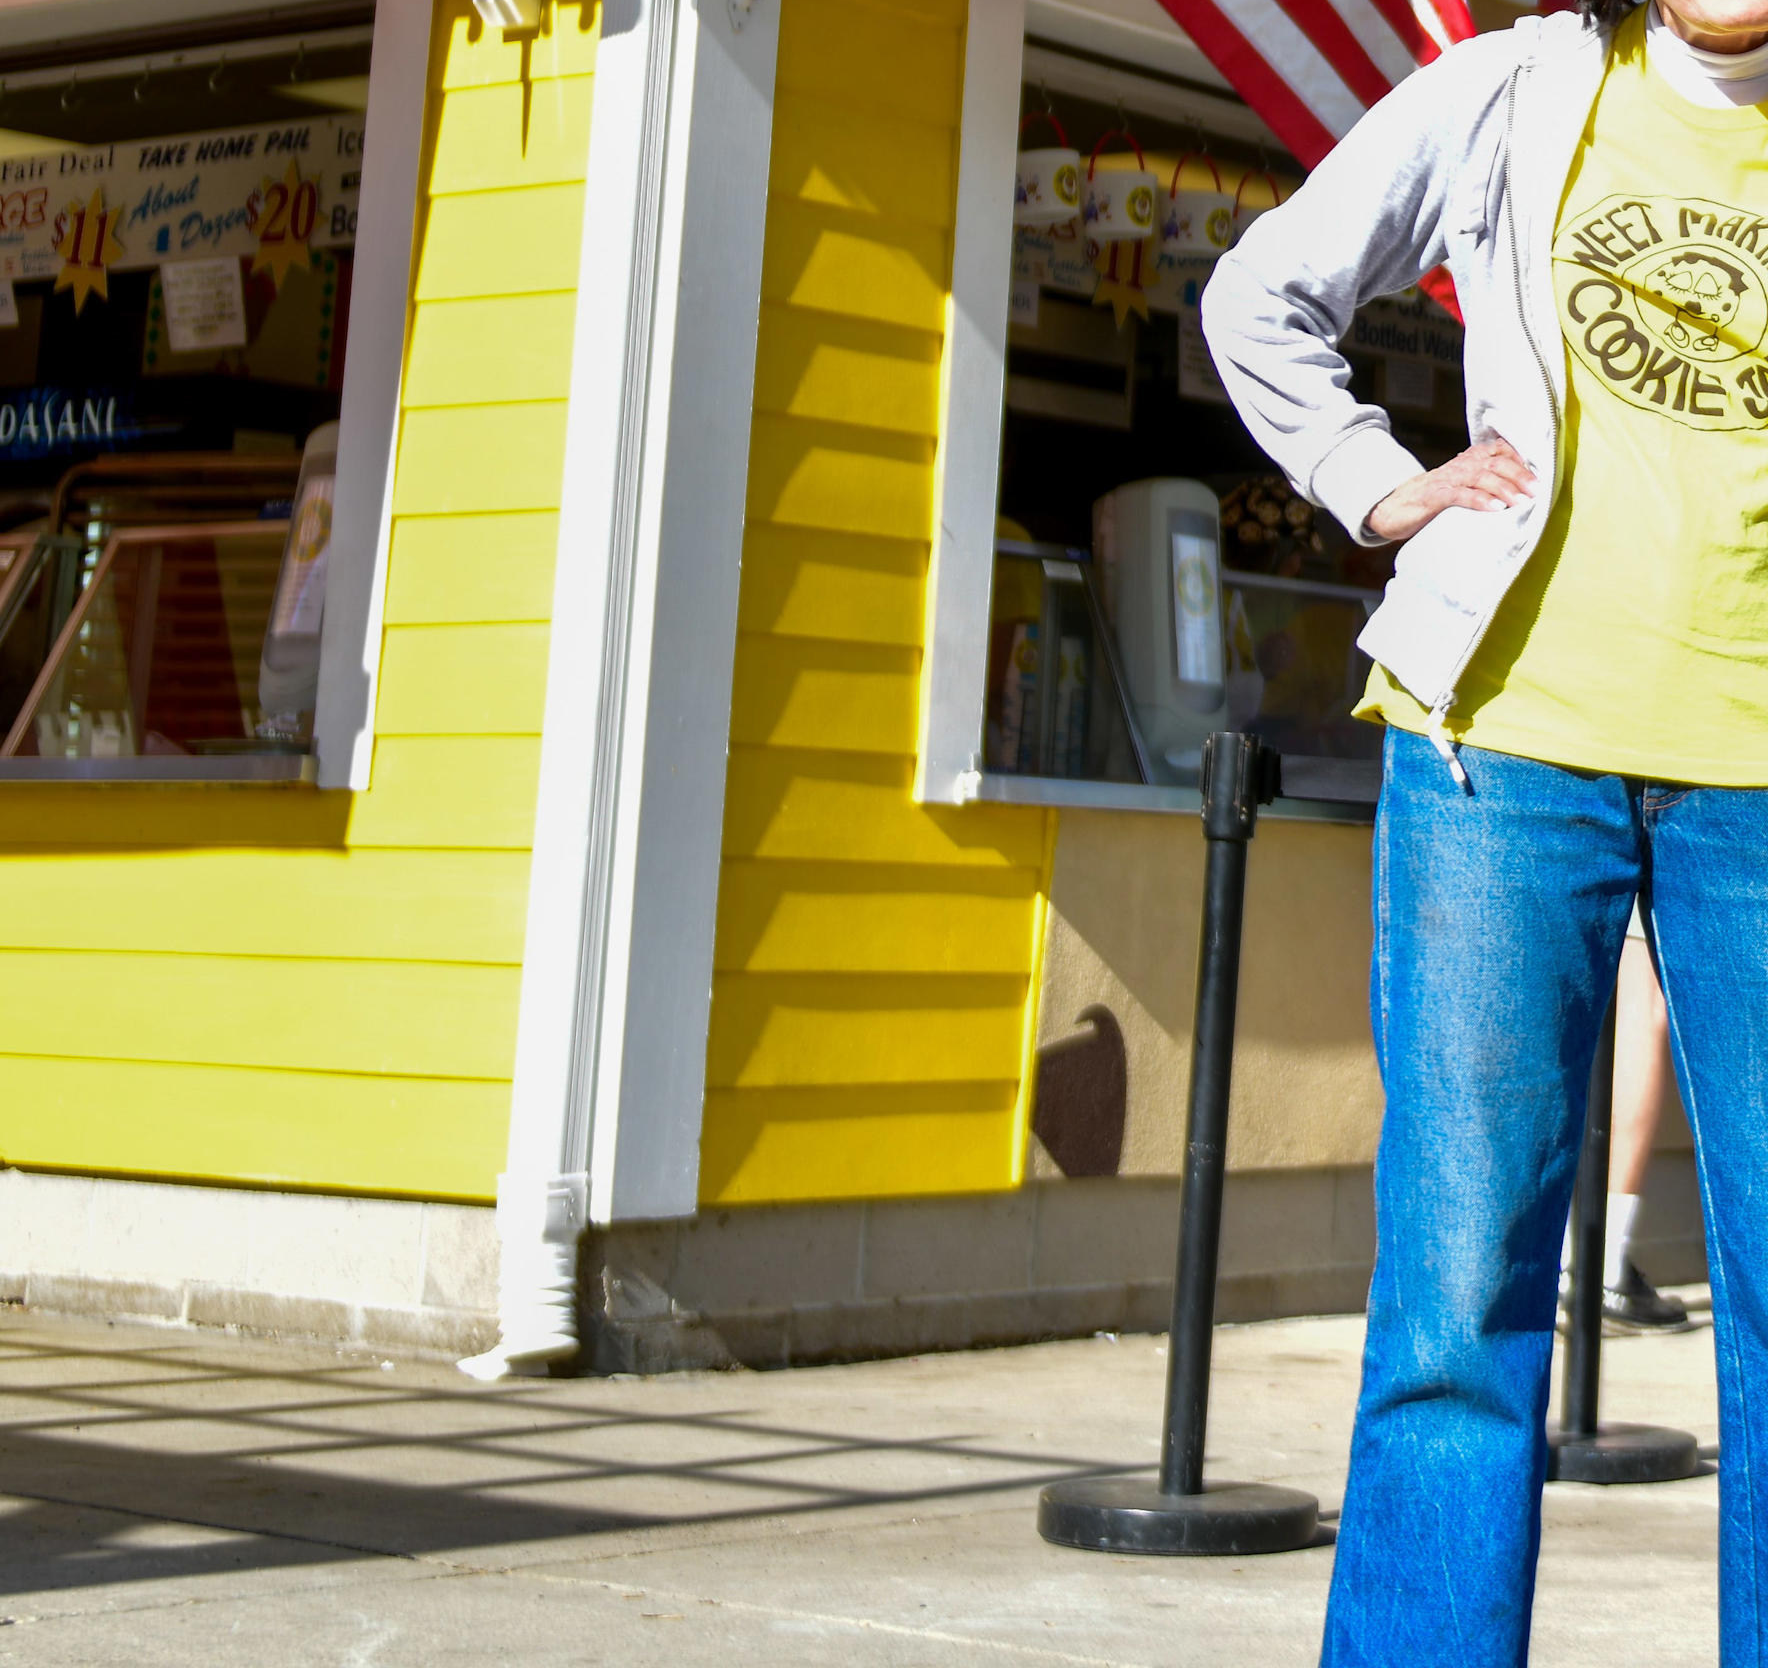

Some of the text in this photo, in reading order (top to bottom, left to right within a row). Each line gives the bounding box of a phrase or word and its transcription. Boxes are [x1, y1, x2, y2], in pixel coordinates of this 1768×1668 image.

[2, 144, 115, 181] Fair Deal
[138, 127, 311, 172] TAKE HOME PAIL
[128, 174, 200, 228] About
[245, 179, 318, 243] $20
[51, 207, 108, 269] $11
[179, 211, 249, 254] Dozen
[1572, 201, 1663, 270] WEET
[1354, 314, 1419, 356] Bottled
[1567, 278, 1728, 418] COOKIE
[0, 391, 117, 445] DASANI
